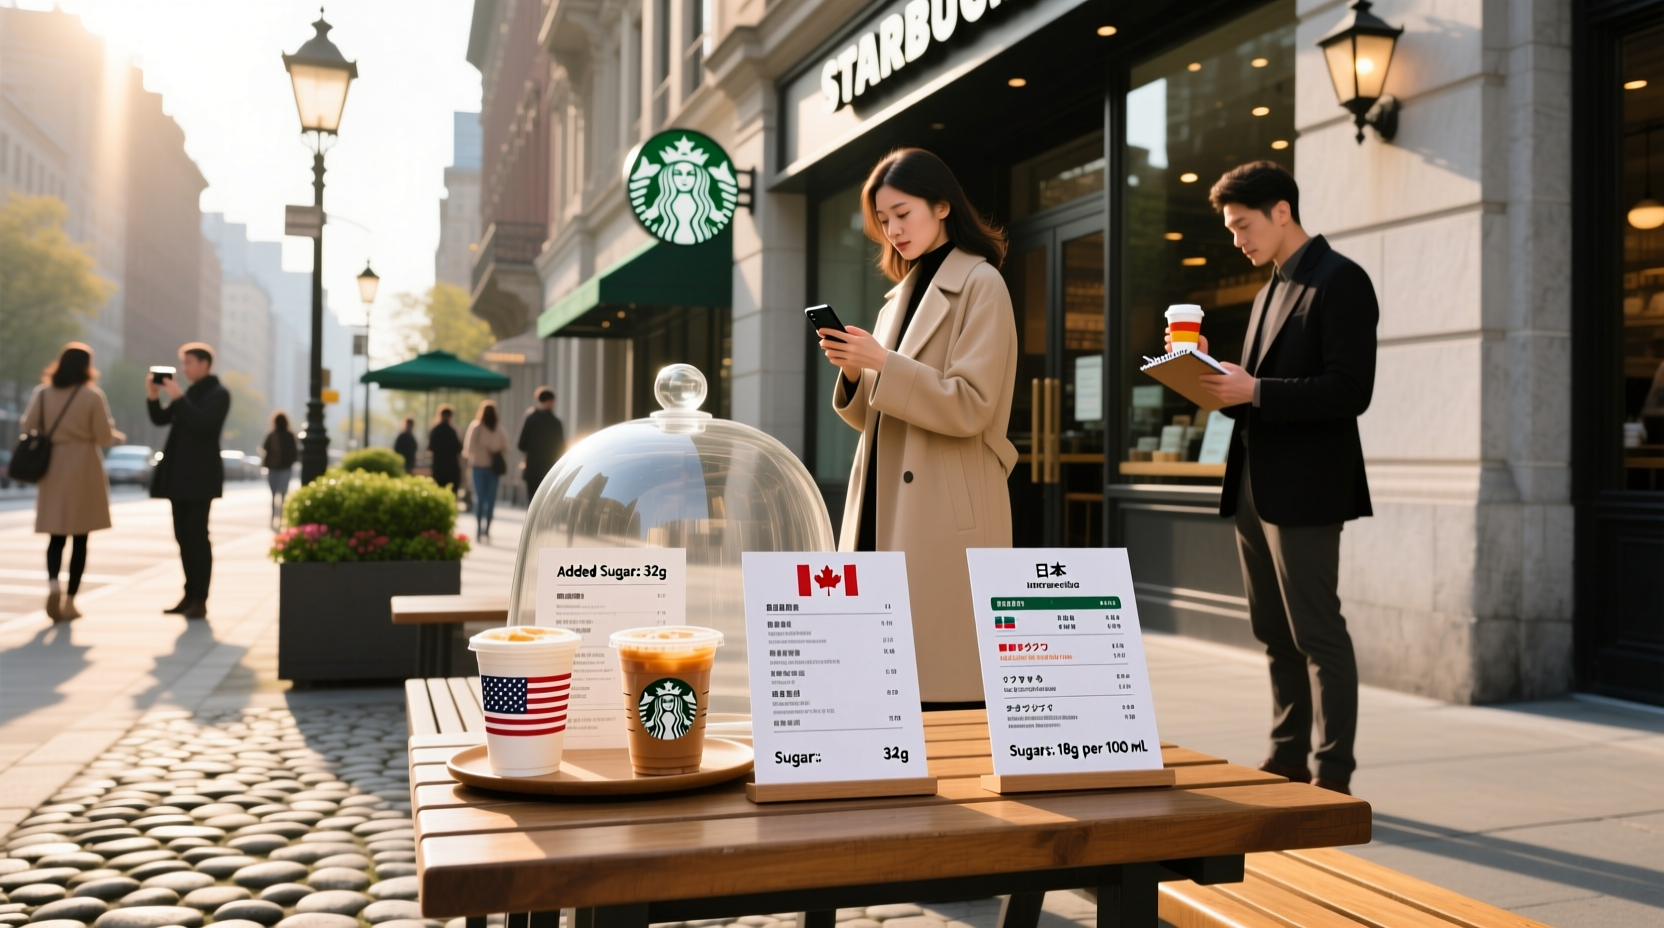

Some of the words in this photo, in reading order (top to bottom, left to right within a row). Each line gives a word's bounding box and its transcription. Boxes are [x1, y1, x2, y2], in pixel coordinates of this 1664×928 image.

[557, 564, 597, 578] Added
[600, 565, 641, 580] Sugar:
[643, 565, 667, 580] 32g
[1036, 561, 1067, 579] 日本
[883, 746, 909, 764] 32g
[1057, 742, 1079, 760] 18g
[1082, 744, 1103, 759] per
[1106, 740, 1129, 754] 100
[1131, 739, 1148, 753] mL
